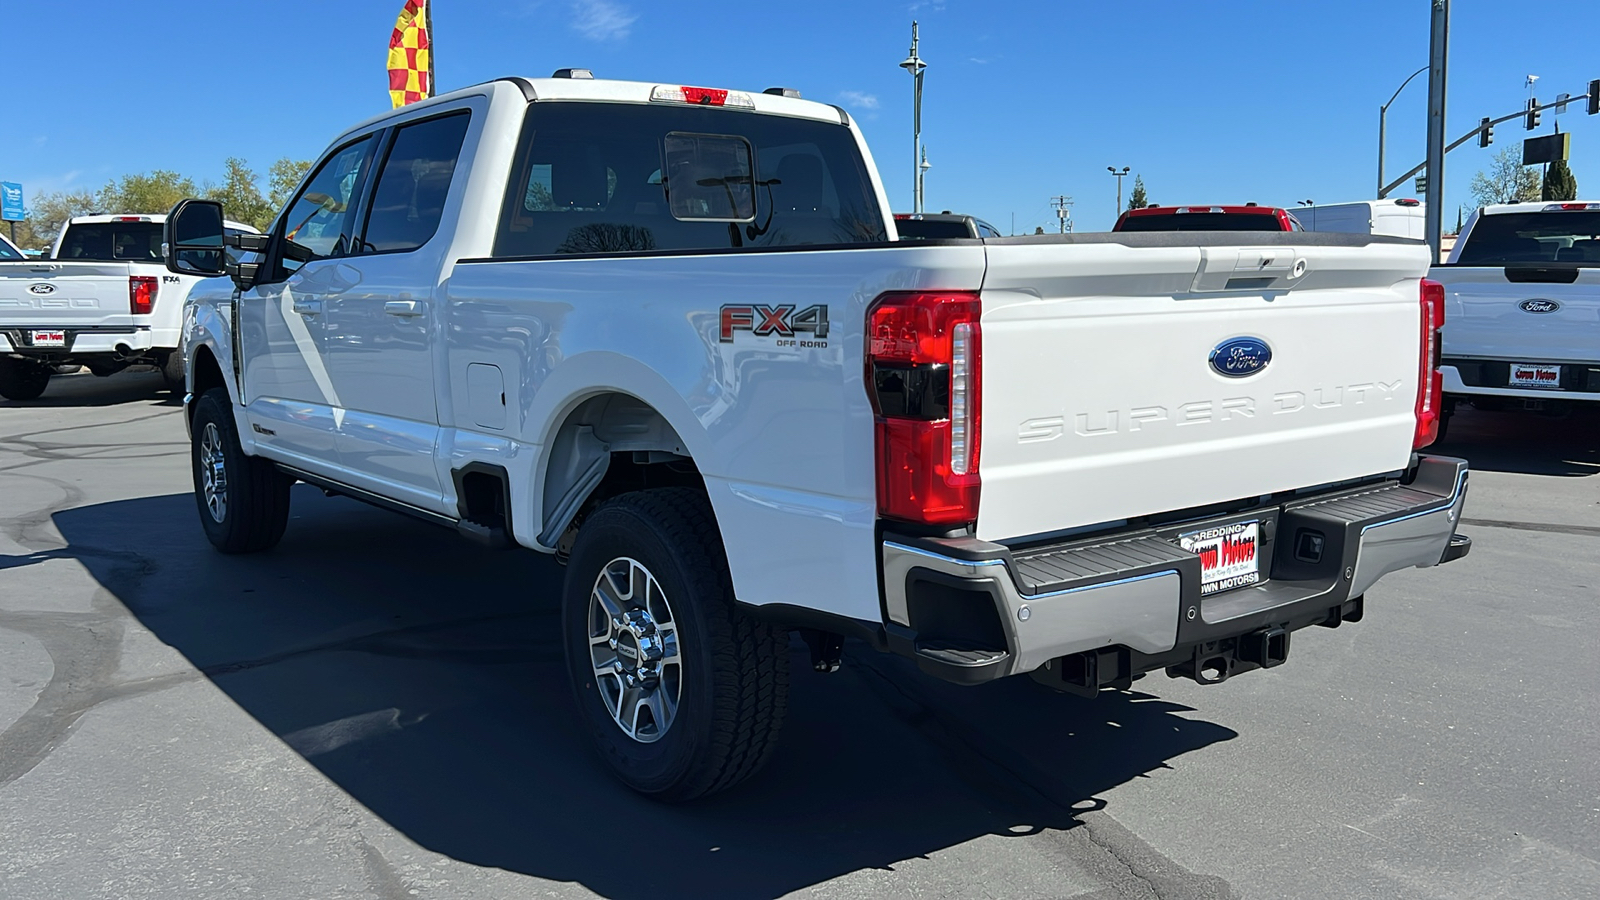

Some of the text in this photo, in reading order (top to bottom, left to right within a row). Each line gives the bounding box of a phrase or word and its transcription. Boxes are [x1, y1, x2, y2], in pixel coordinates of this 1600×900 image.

[162, 275, 181, 284] FX4
[1525, 301, 1553, 311] Ford
[719, 303, 830, 343] FX4
[800, 341, 828, 349] ROAD
[1226, 346, 1262, 370] Ford
[1018, 379, 1402, 443] SUPER DUTY
[1199, 524, 1242, 541] REDDING
[1221, 535, 1255, 567] Motors
[1220, 573, 1255, 590] MOTORS
